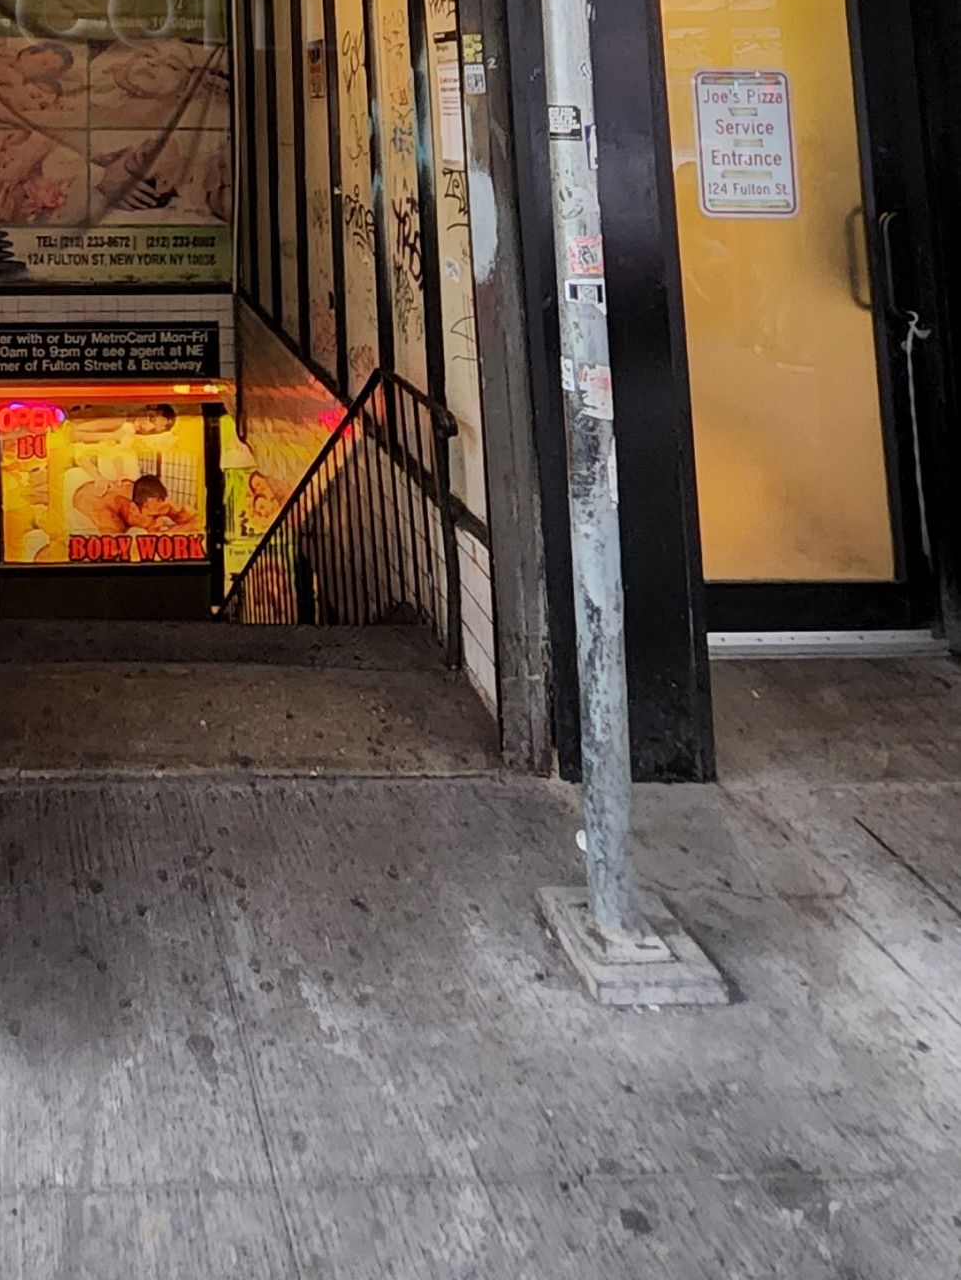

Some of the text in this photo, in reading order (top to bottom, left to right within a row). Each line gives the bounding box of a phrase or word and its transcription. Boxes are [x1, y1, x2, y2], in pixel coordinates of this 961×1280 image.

[487, 57, 497, 69] 2
[702, 88, 784, 104] Joe's Pizza
[714, 118, 775, 136] Service
[711, 149, 783, 167] Entrance
[707, 182, 728, 196] 124
[732, 182, 771, 196] Fulton
[35, 235, 58, 248] TEL:
[146, 235, 171, 250] (212)
[27, 253, 45, 266] 124
[47, 253, 89, 266] FULTON
[109, 253, 135, 266] NEW
[136, 253, 166, 266] YORK
[168, 253, 184, 266] NY
[17, 331, 42, 345] with
[47, 335, 60, 345] or
[63, 331, 88, 348] buy
[91, 331, 157, 345] MetroCard
[160, 330, 208, 344] Mon-Fri
[32, 346, 46, 358] to
[84, 348, 98, 358] or
[102, 348, 126, 358] see
[130, 346, 166, 360] agent
[169, 345, 182, 357] at
[186, 344, 204, 357] NE
[25, 359, 39, 371] of
[42, 358, 80, 372] Fulton
[84, 358, 123, 371] Street
[127, 359, 136, 371] &
[141, 358, 203, 373] Broadway
[68, 533, 207, 562] BODY WORK
